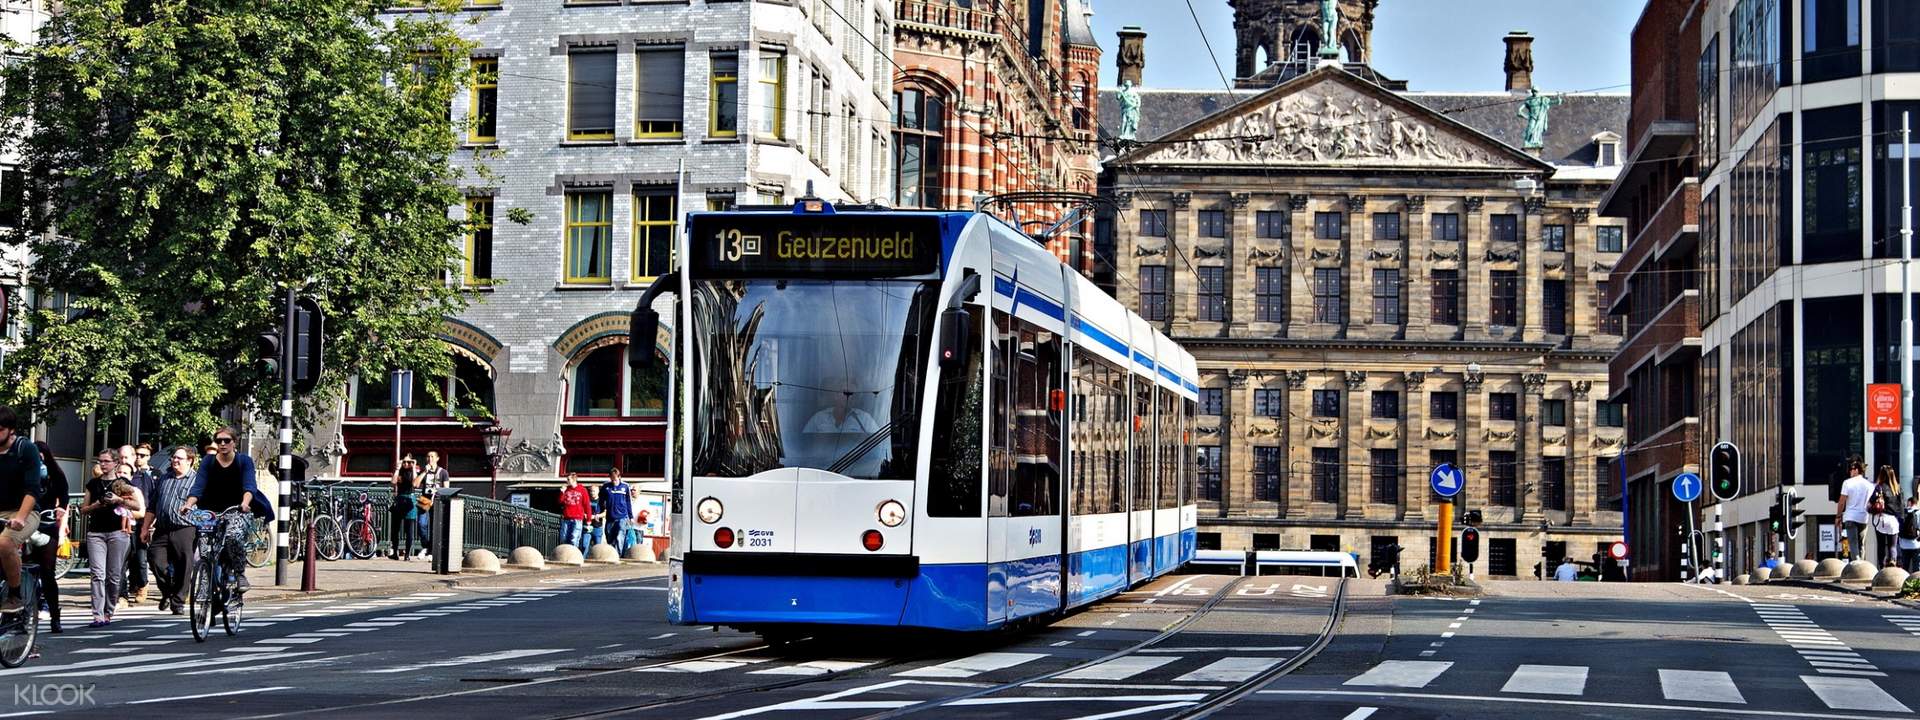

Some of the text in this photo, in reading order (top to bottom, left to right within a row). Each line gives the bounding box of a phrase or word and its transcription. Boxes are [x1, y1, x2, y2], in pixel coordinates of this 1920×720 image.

[715, 229, 914, 262] 13 Geuzenveld
[750, 538, 772, 547] 2031
